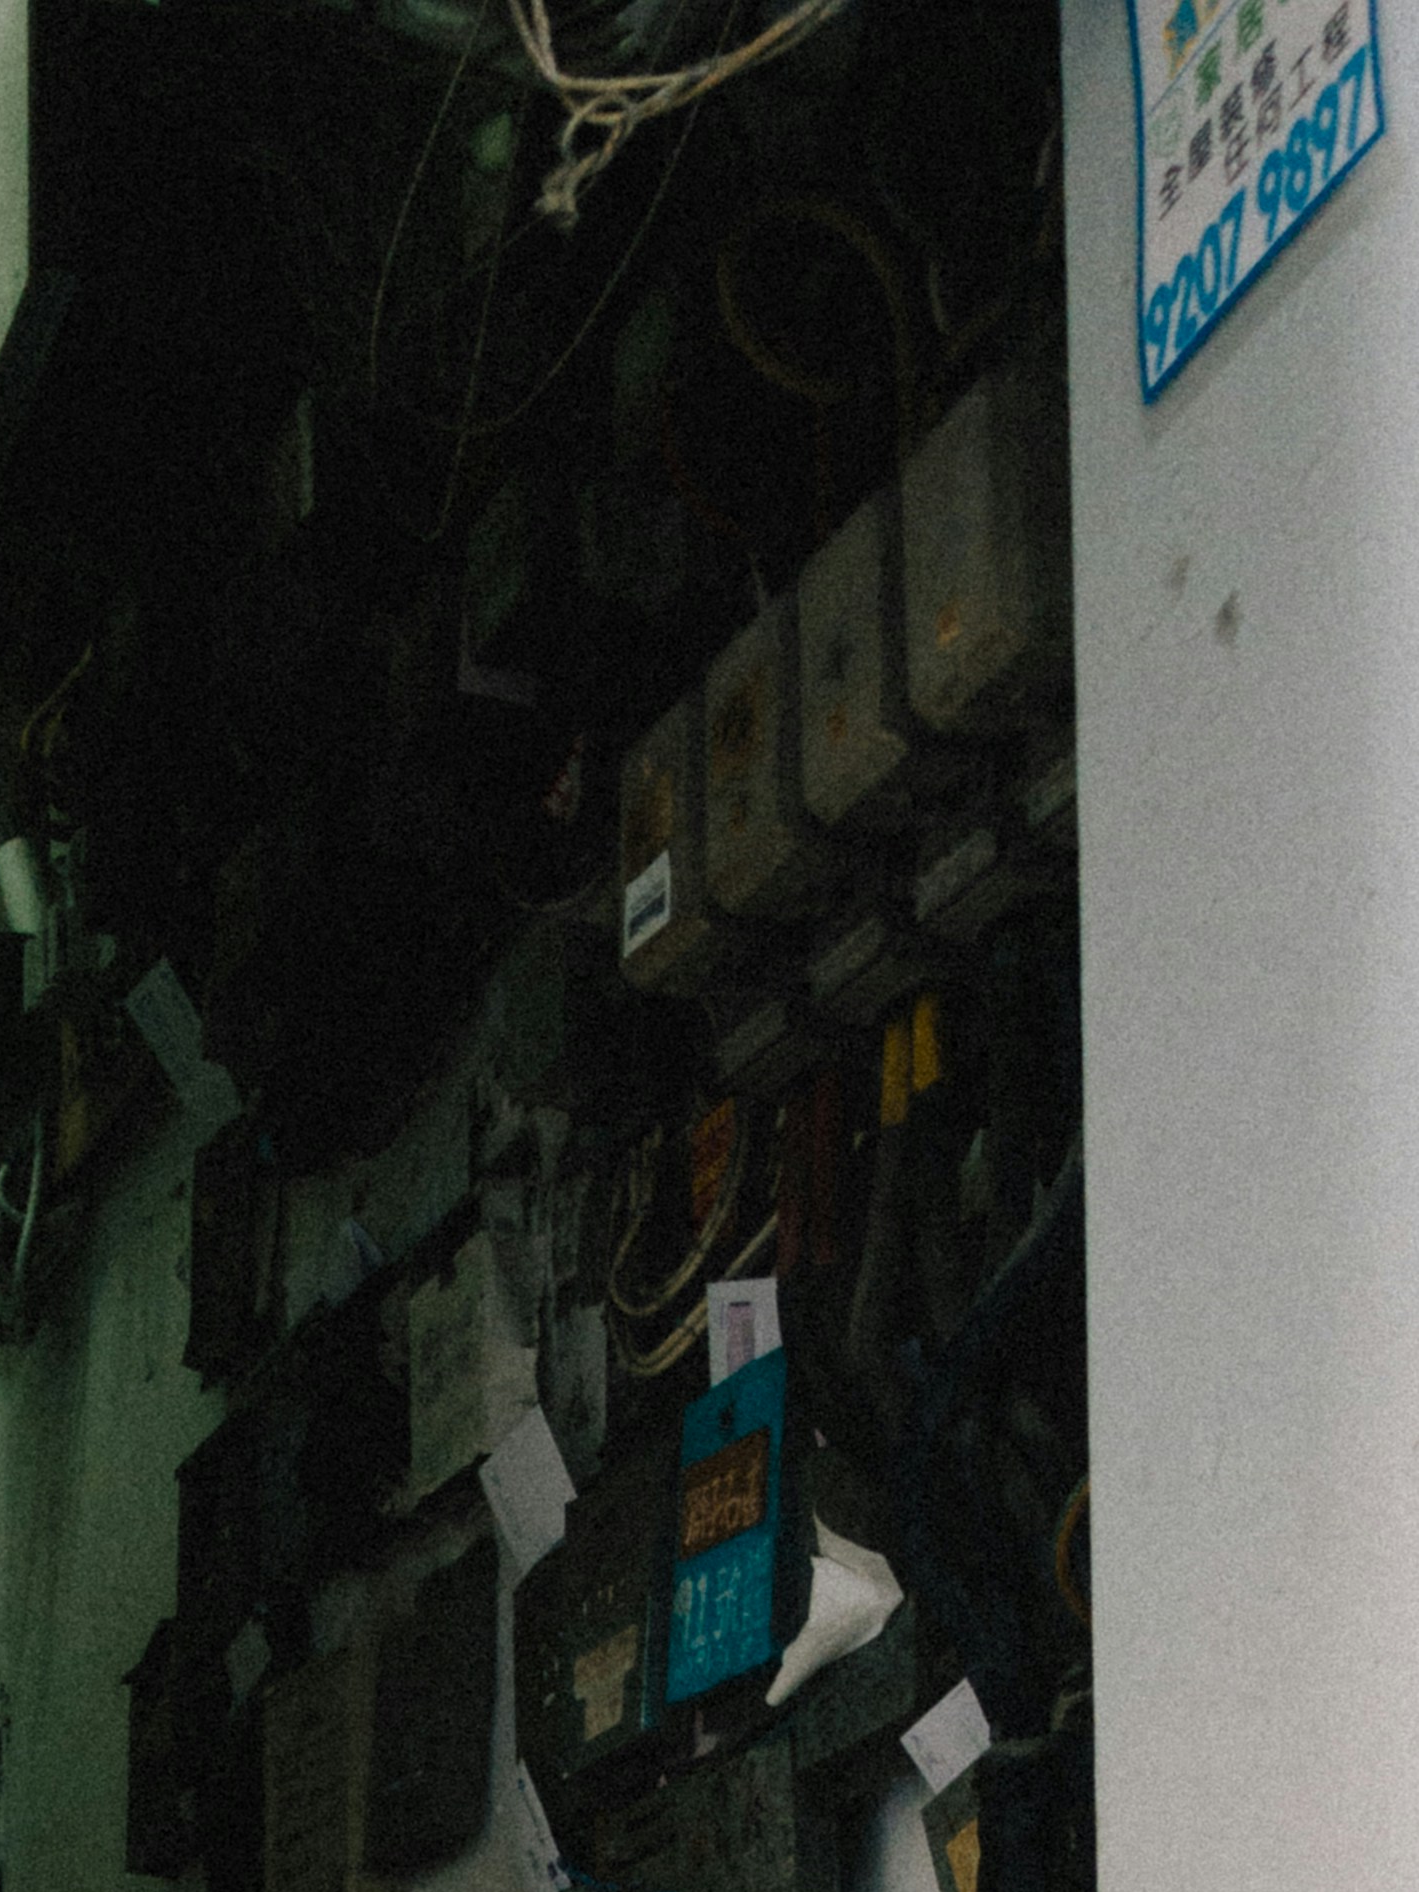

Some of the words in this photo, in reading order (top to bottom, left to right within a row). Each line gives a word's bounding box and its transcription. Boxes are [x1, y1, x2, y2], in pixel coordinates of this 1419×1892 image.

[1146, 187, 1245, 374] 9207
[1257, 43, 1366, 243] 9897
[1223, 1, 1350, 187] 任何工程
